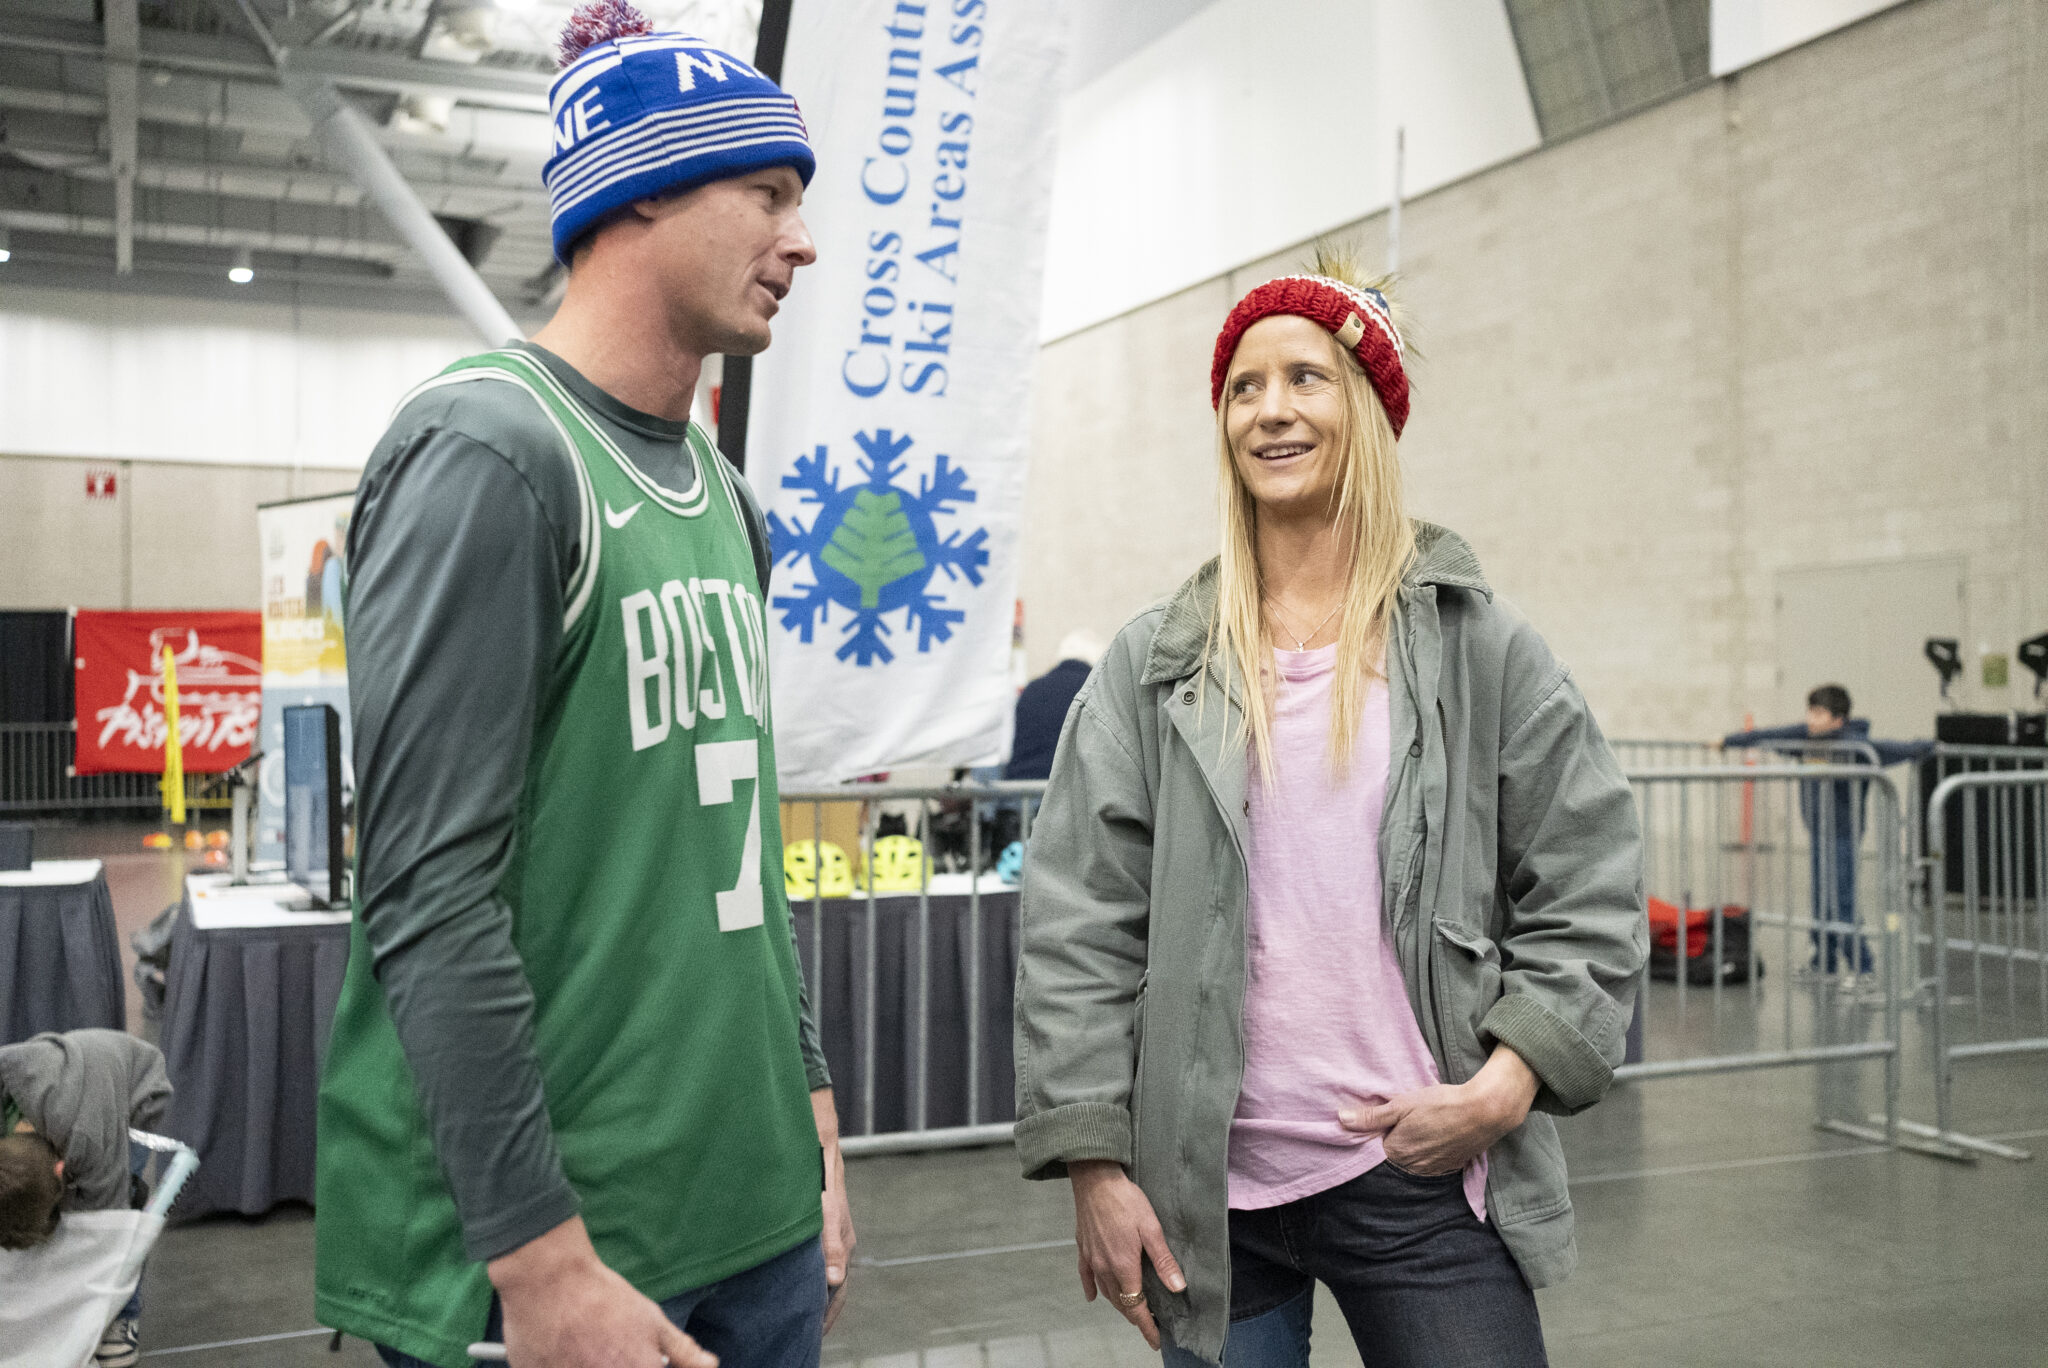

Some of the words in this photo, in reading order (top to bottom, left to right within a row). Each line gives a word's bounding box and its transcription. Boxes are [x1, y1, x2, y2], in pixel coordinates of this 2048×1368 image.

[914, 111, 974, 284] Areas
[842, 231, 902, 398] Cross
[900, 301, 954, 398] Ski
[694, 739, 764, 932] 7
